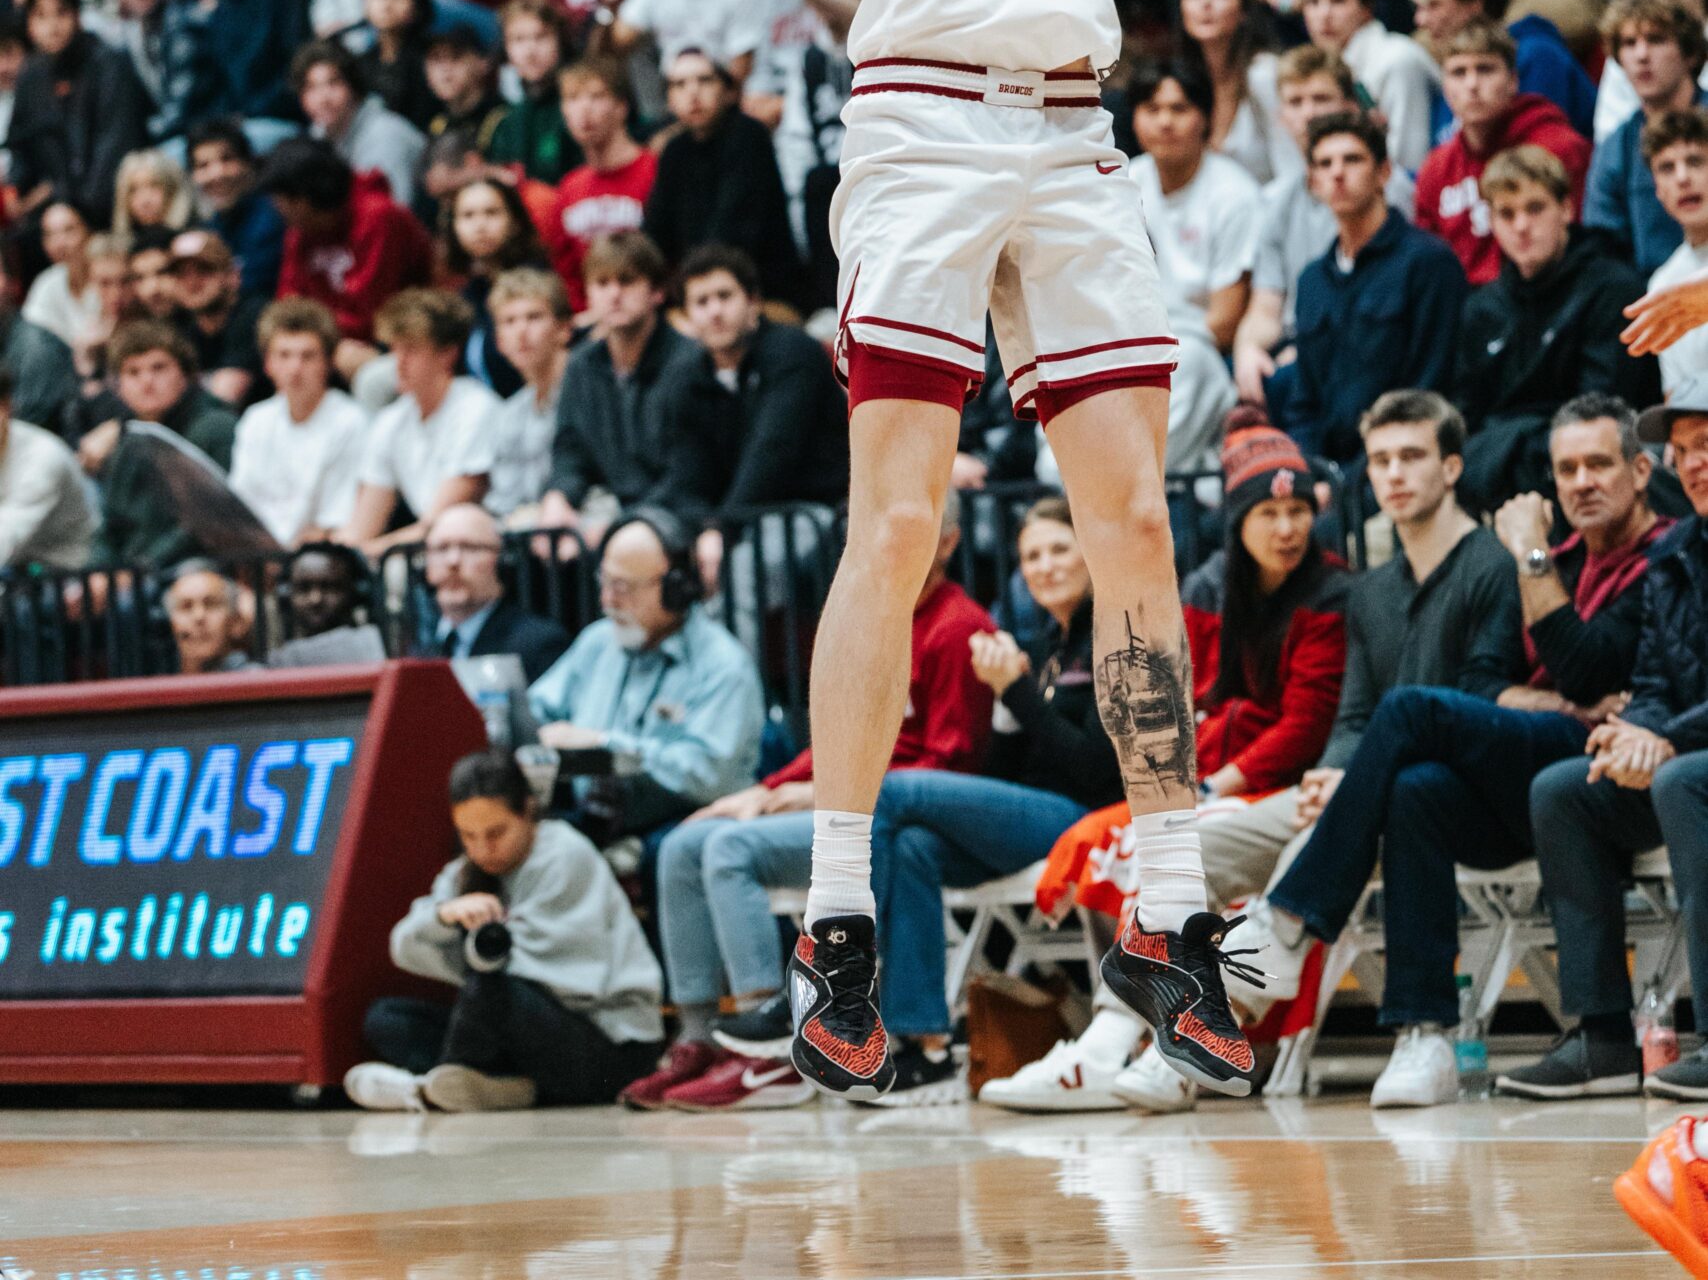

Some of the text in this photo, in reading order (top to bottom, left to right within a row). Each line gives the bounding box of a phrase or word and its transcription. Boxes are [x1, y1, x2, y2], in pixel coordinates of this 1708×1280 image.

[998, 83, 1035, 97] BRONCOS
[77, 737, 354, 866] COAST
[39, 891, 312, 966] institute
